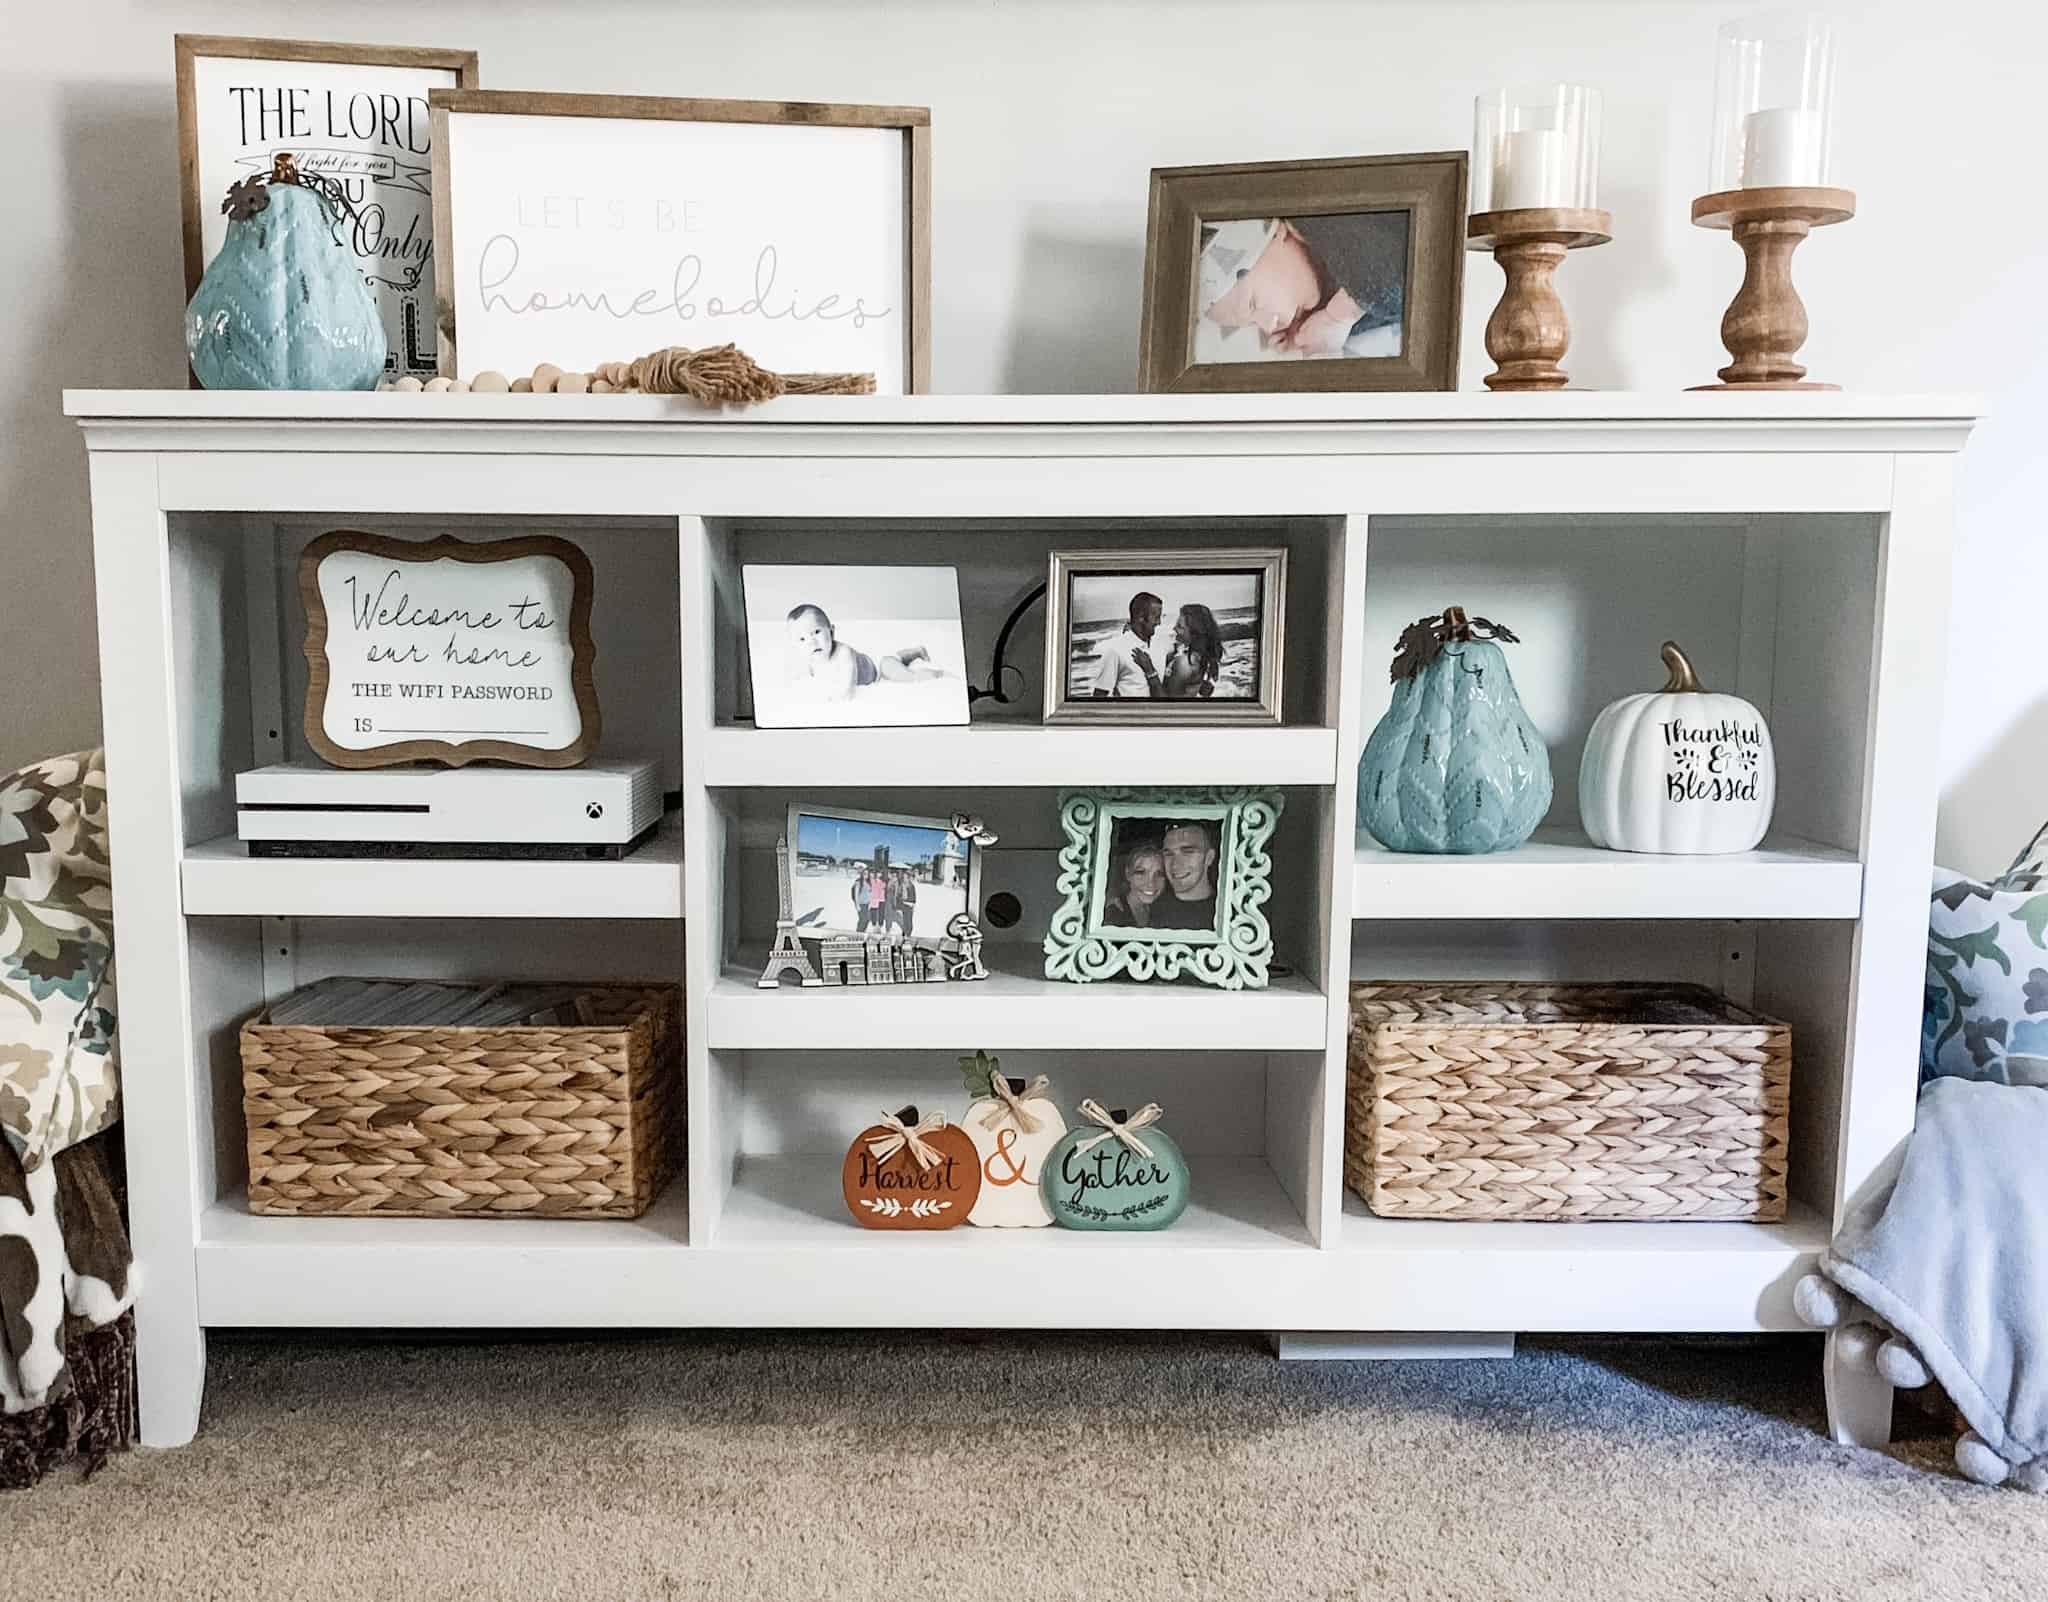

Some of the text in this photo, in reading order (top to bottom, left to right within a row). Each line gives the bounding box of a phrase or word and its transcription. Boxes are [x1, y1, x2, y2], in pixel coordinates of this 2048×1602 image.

[229, 87, 431, 154] THE LORD
[514, 193, 704, 232] LETS BE
[353, 203, 434, 282] Only
[479, 234, 891, 328] homebodies
[344, 570, 554, 630] Welcome to
[367, 632, 541, 667] our home
[352, 683, 553, 701] THE WIFI PASSWORD
[354, 717, 373, 733] IS
[1658, 718, 1763, 751] Thankful
[1708, 745, 1733, 774] &
[1666, 769, 1759, 803] Blessed
[859, 1129, 1170, 1204] Harvest & Gather
